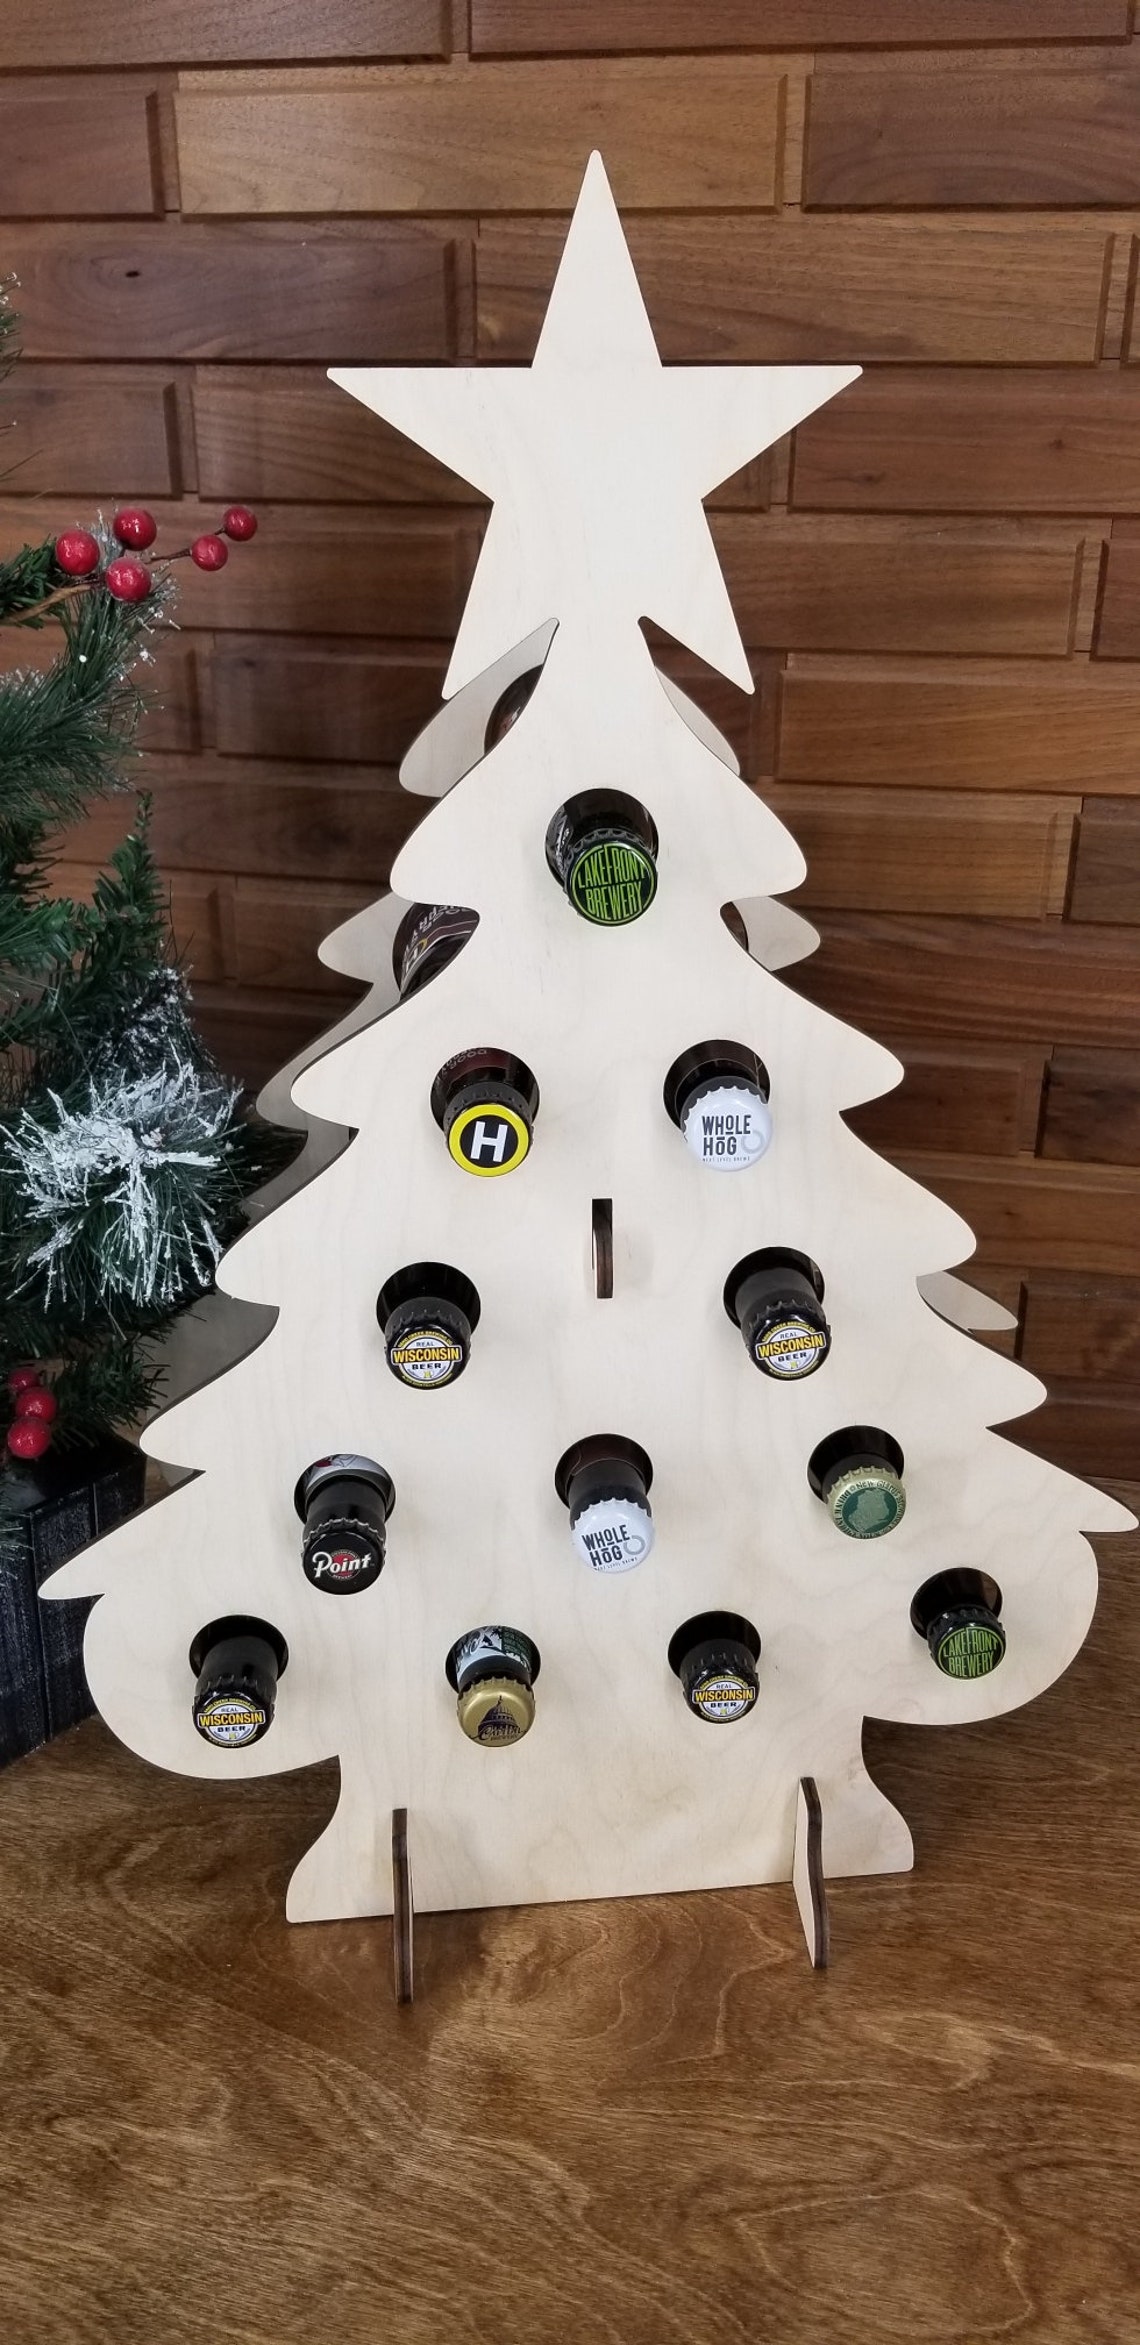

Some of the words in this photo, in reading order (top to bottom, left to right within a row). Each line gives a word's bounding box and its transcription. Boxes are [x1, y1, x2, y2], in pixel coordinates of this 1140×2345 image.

[577, 844, 646, 888] LAKEFRONT
[585, 881, 642, 920] BREWERY
[701, 1115, 751, 1135] WHOLE
[470, 1121, 508, 1162] H
[393, 1348, 459, 1363] WISCONSIN
[758, 1334, 824, 1358] WISCONSIN
[778, 1352, 807, 1362] BEER
[582, 1524, 630, 1551] WHOLE
[312, 1551, 372, 1578] Point
[943, 1627, 998, 1657] LAKEFRONT
[948, 1651, 994, 1677] BREWERY
[695, 1689, 753, 1702] WISCONSIN
[200, 1712, 263, 1727] WISCONSIN
